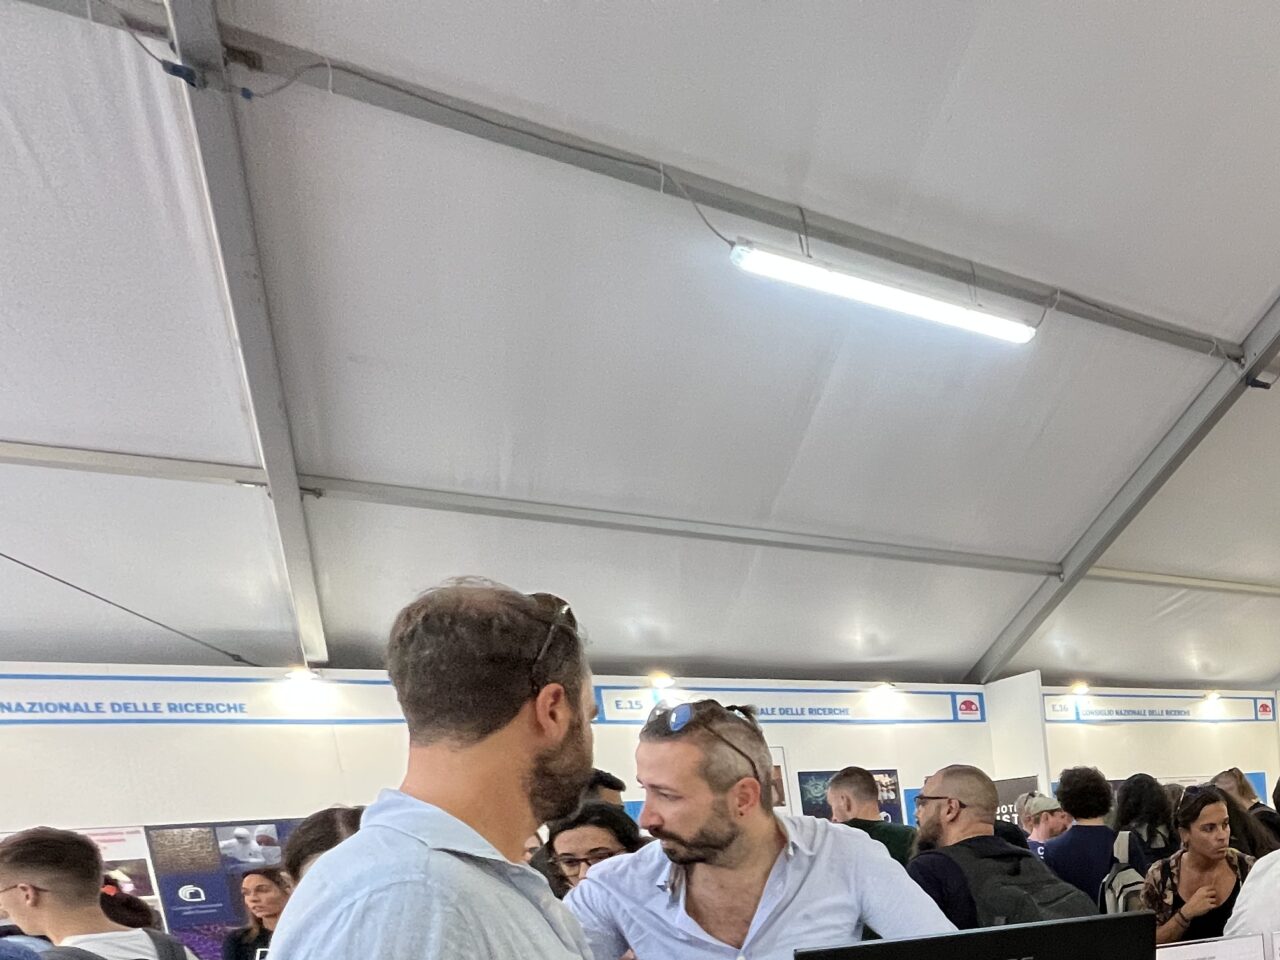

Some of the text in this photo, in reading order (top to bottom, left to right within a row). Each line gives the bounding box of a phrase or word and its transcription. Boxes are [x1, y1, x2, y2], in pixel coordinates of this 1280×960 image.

[0, 702, 248, 714] NAZIONALE DELLE RICERCHE
[778, 706, 807, 716] DELLE
[808, 707, 850, 716] RICERCHE
